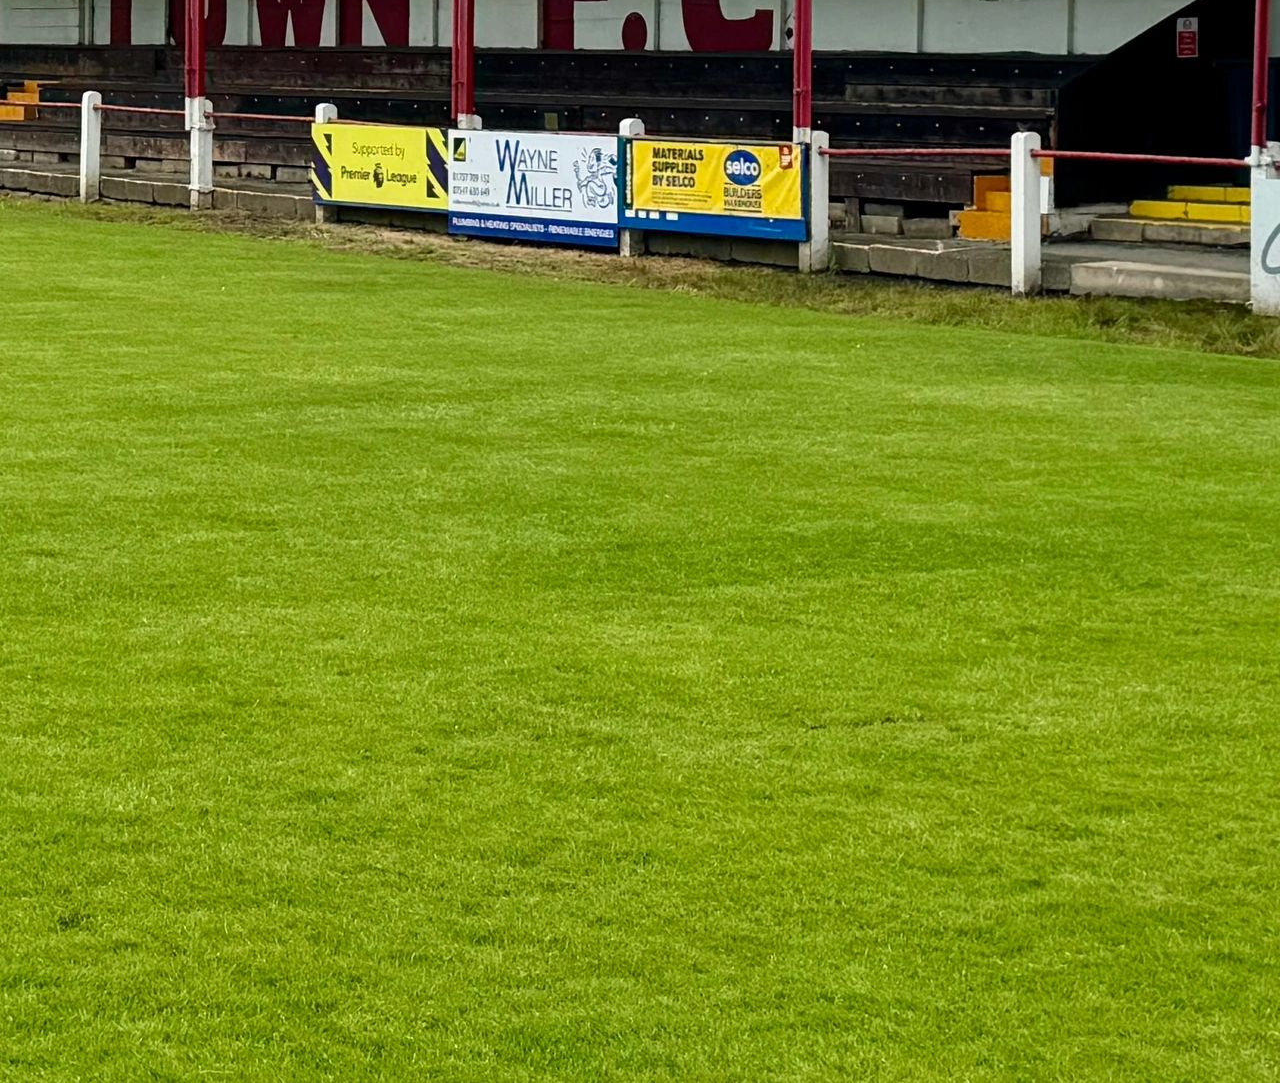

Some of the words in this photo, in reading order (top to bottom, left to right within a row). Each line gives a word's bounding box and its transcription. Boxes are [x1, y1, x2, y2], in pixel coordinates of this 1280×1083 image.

[352, 142, 393, 157] Supported
[394, 143, 405, 160] by
[495, 139, 558, 172] WAYNE
[652, 147, 705, 162] MATERIALS
[340, 165, 371, 180] Premier
[386, 168, 418, 186] League
[652, 161, 697, 175] SUPPLIED
[725, 157, 760, 176] selco
[506, 172, 573, 209] MILLER
[652, 175, 664, 187] BY
[666, 175, 696, 189] SELCO
[723, 186, 763, 199] BUILDERS
